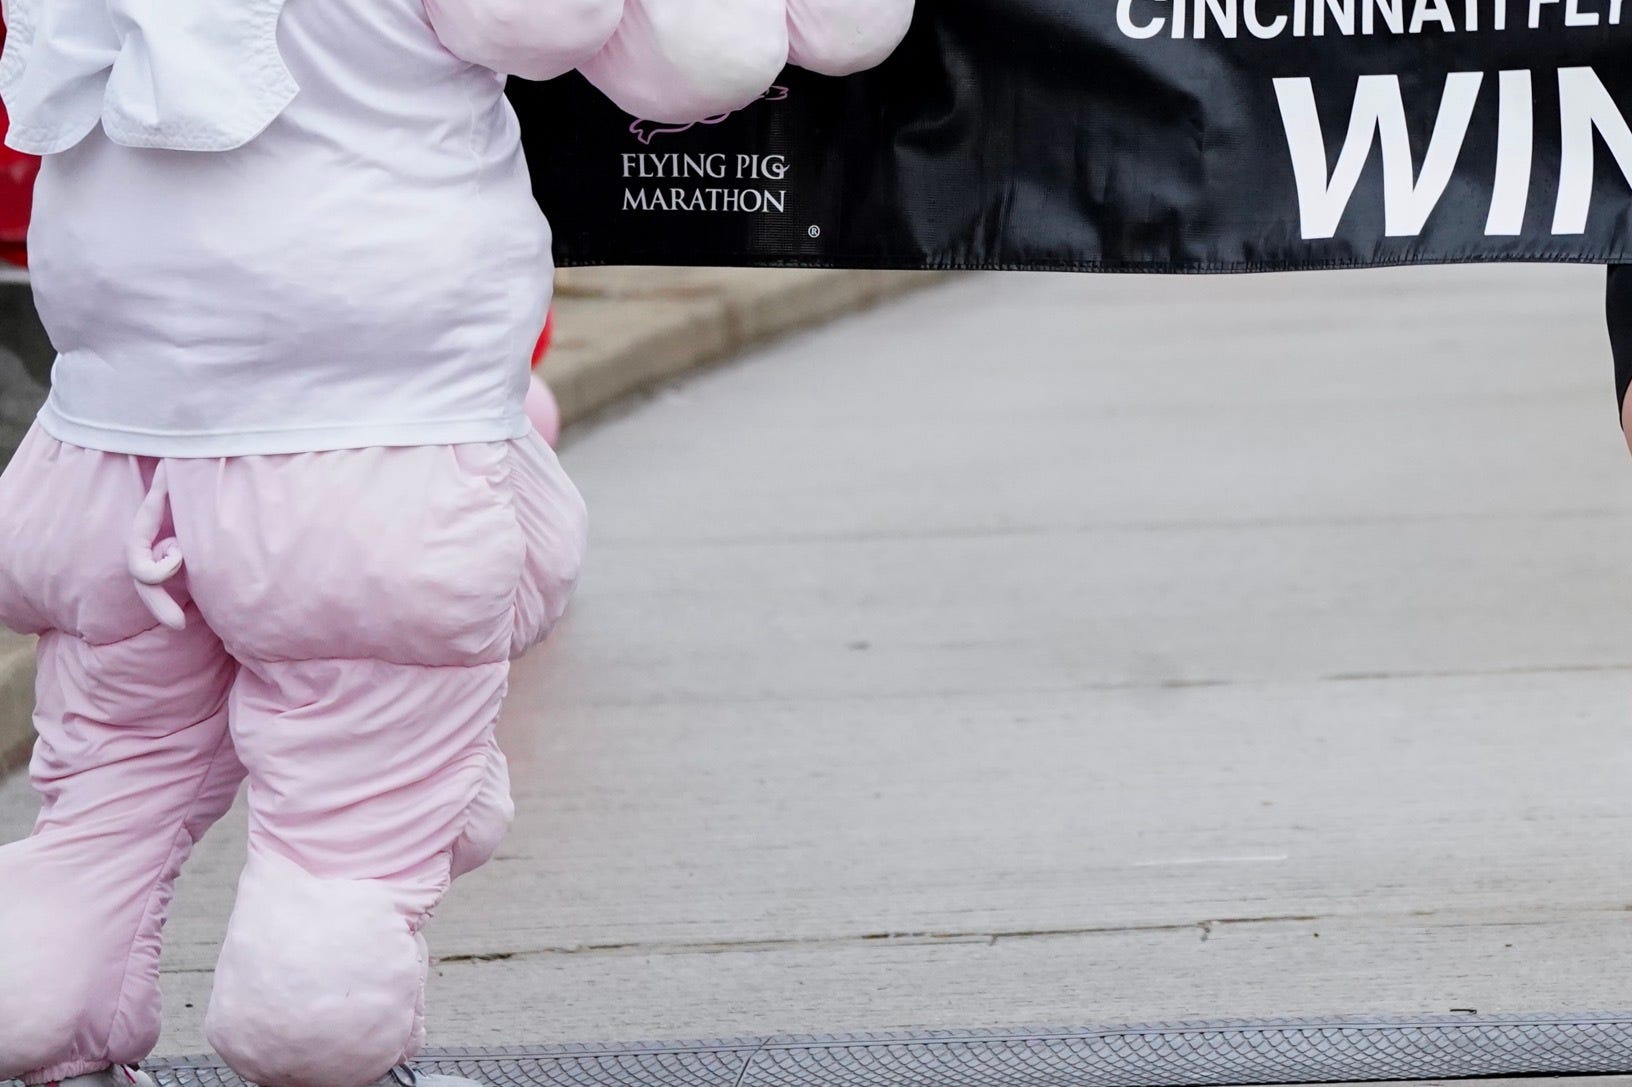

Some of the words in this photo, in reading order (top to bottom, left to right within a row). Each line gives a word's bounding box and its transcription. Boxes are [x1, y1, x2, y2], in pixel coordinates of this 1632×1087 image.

[621, 153, 726, 178] FLYING
[736, 154, 791, 180] PIG
[622, 187, 787, 213] MARATHON
